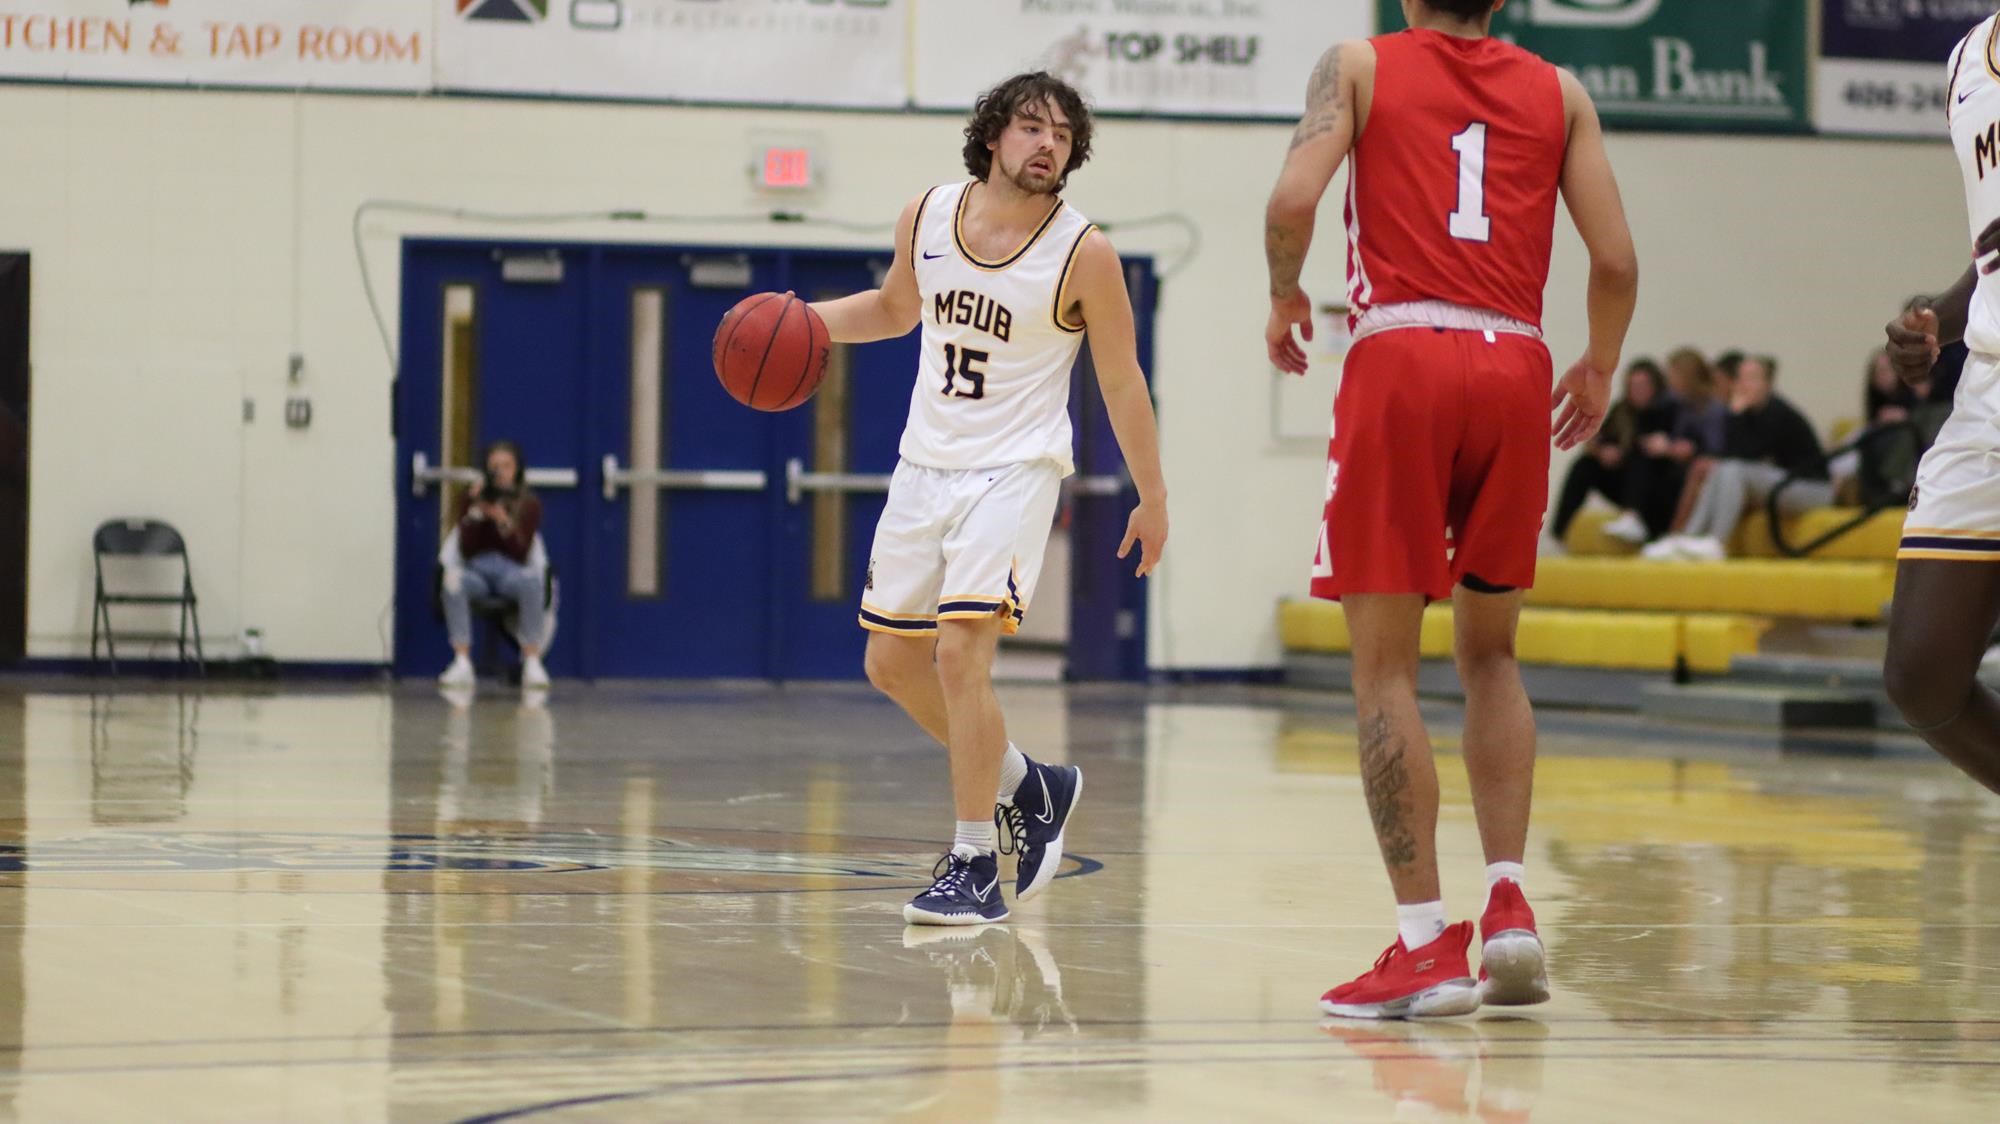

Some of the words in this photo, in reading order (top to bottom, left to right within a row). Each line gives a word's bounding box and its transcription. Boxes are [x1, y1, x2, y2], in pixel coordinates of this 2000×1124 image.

[149, 23, 182, 56] &
[204, 23, 282, 60] TAP
[297, 27, 421, 63] ROOM
[1105, 32, 1161, 63] TOP
[1174, 34, 1260, 66] SHELF
[1649, 36, 1783, 101] Bank
[1974, 120, 2000, 181] M
[1449, 121, 1490, 242] 1
[934, 289, 1012, 343] MSUB
[941, 342, 989, 400] 15
